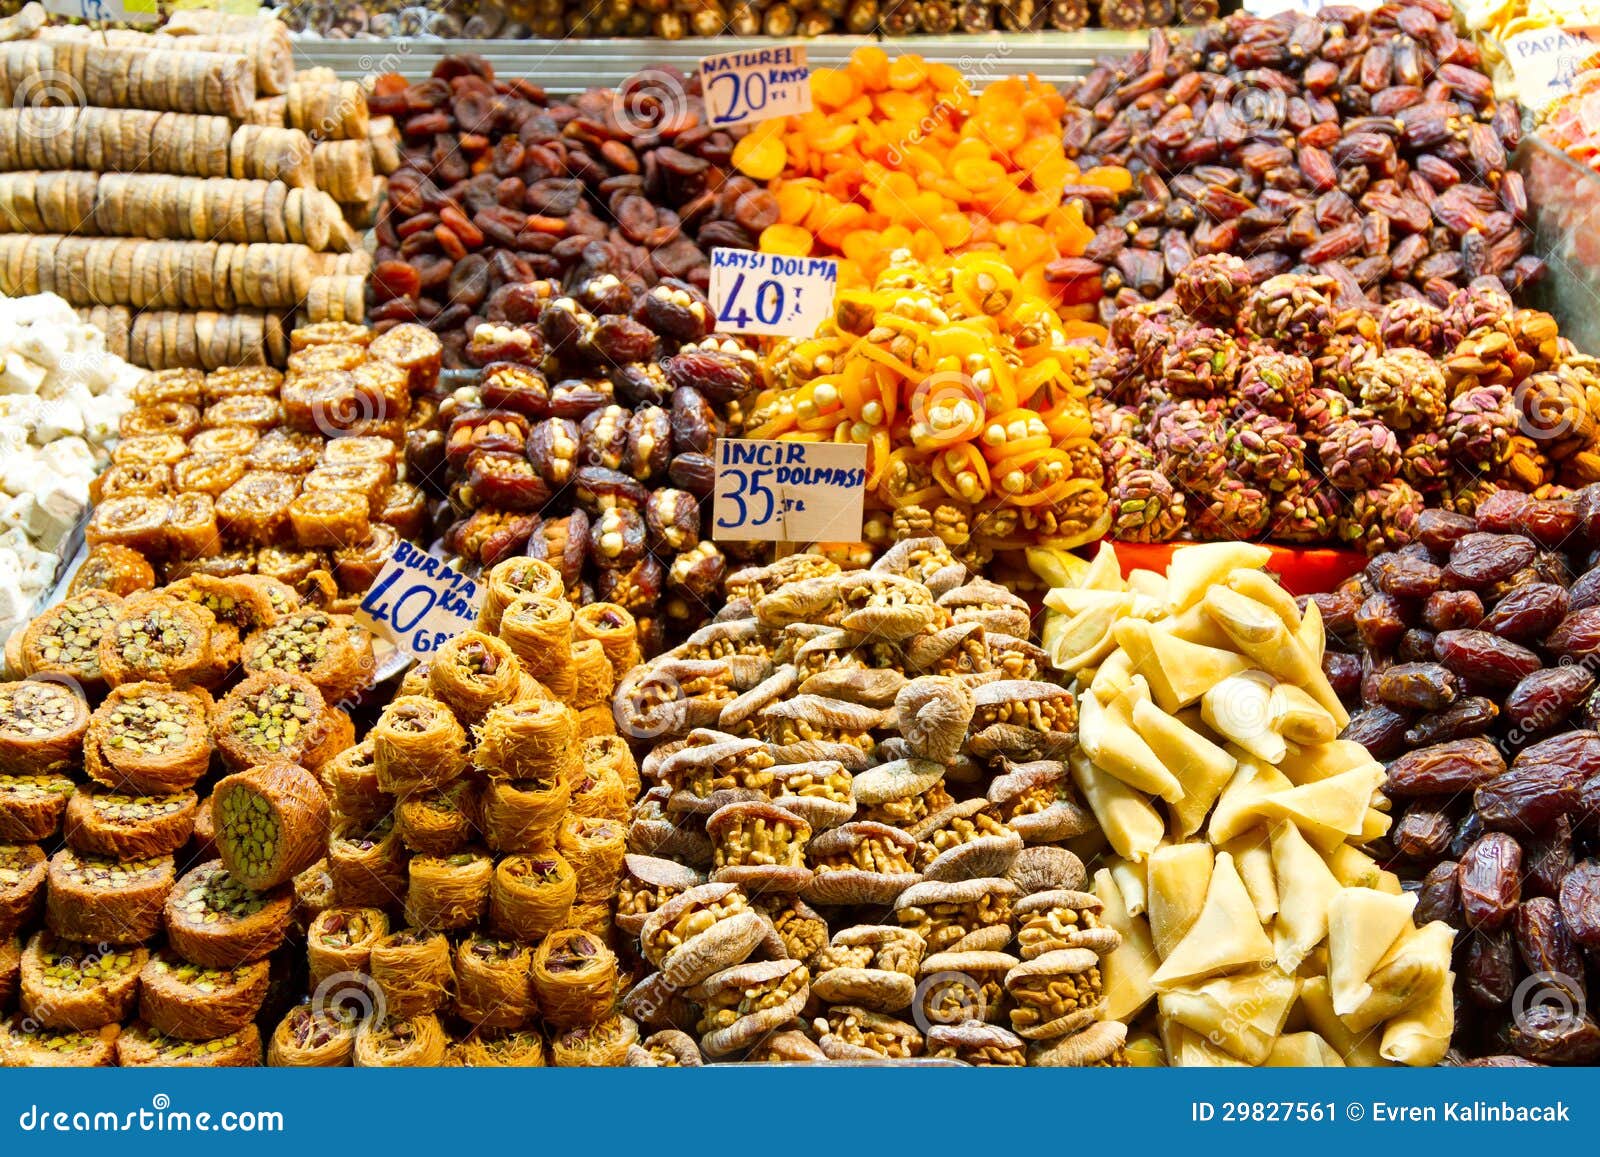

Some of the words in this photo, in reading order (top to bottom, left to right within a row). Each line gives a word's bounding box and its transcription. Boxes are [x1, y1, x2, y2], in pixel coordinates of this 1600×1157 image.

[708, 72, 767, 123] 20
[771, 256, 837, 282] DOLMA
[718, 273, 784, 328] 40
[776, 466, 866, 488] DOLMASI
[392, 541, 476, 598] BURMA
[360, 568, 437, 633] 40
